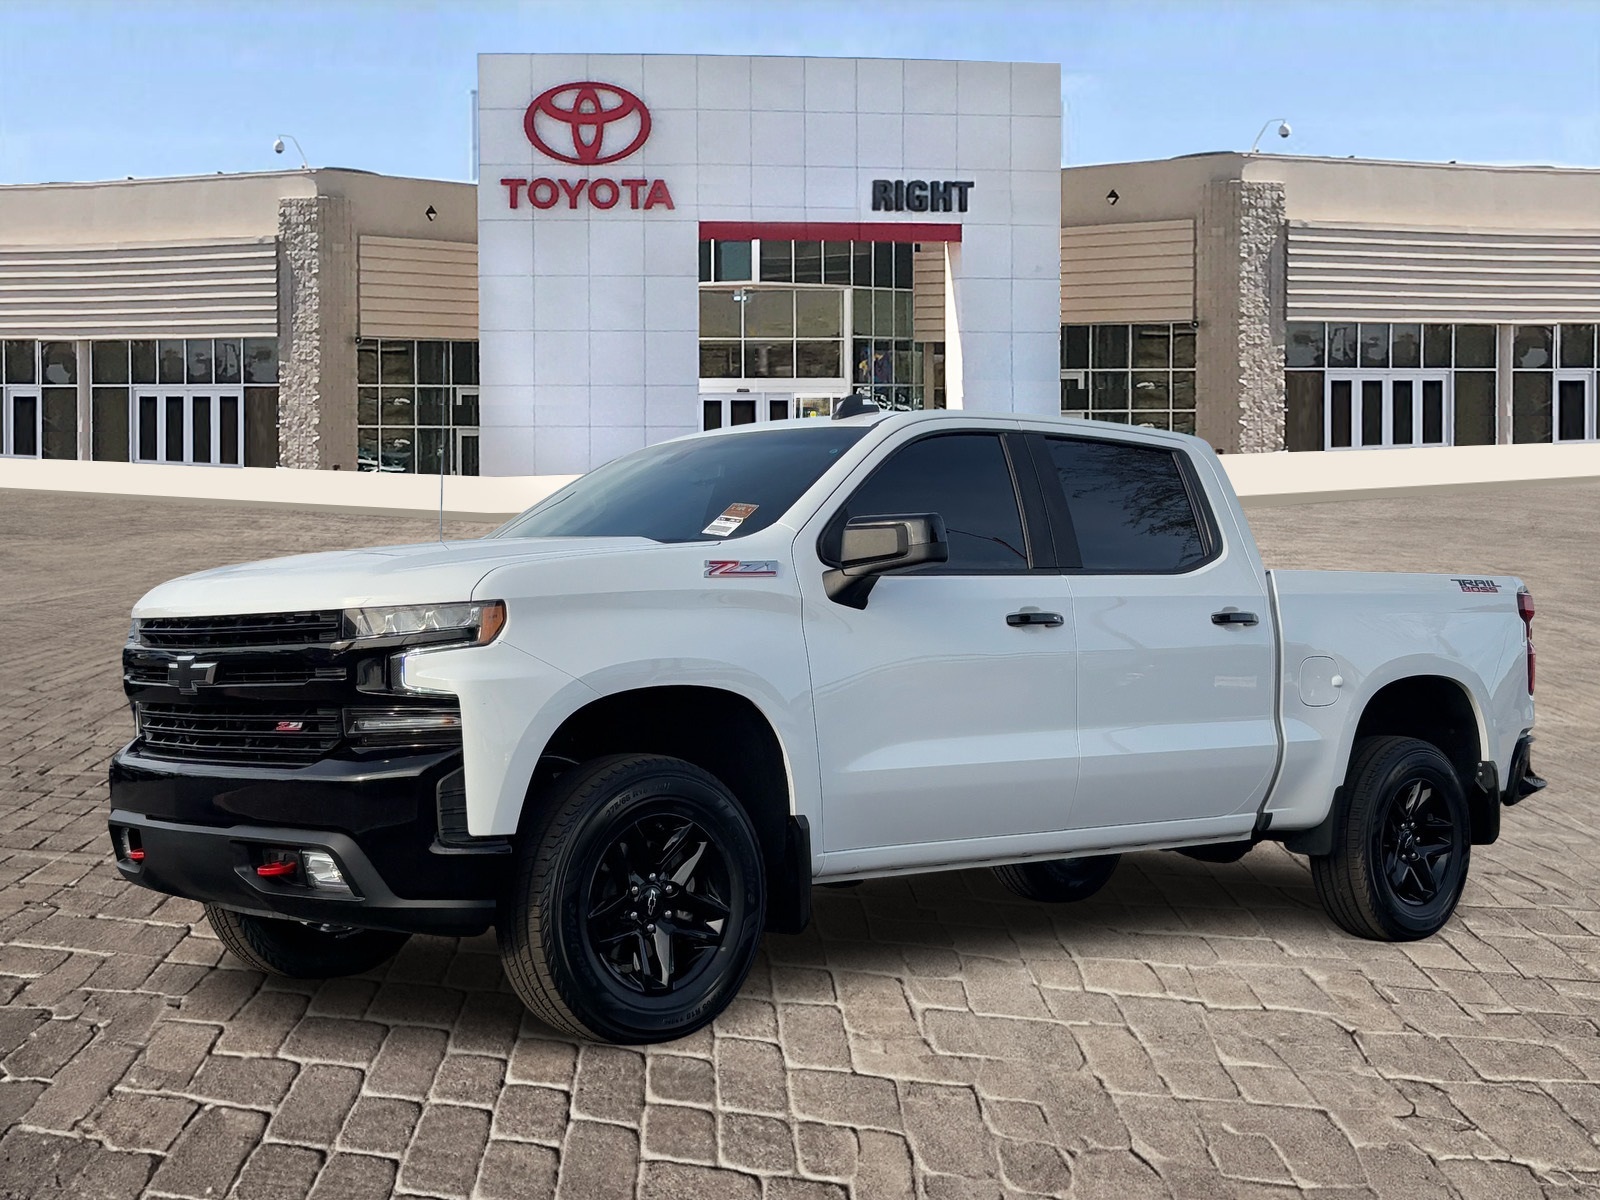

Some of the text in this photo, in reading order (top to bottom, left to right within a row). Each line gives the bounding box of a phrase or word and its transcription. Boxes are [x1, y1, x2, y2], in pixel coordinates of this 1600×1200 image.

[500, 178, 675, 209] TOYOTA
[872, 180, 975, 212] RIGHT
[1450, 579, 1502, 587] TRAIL
